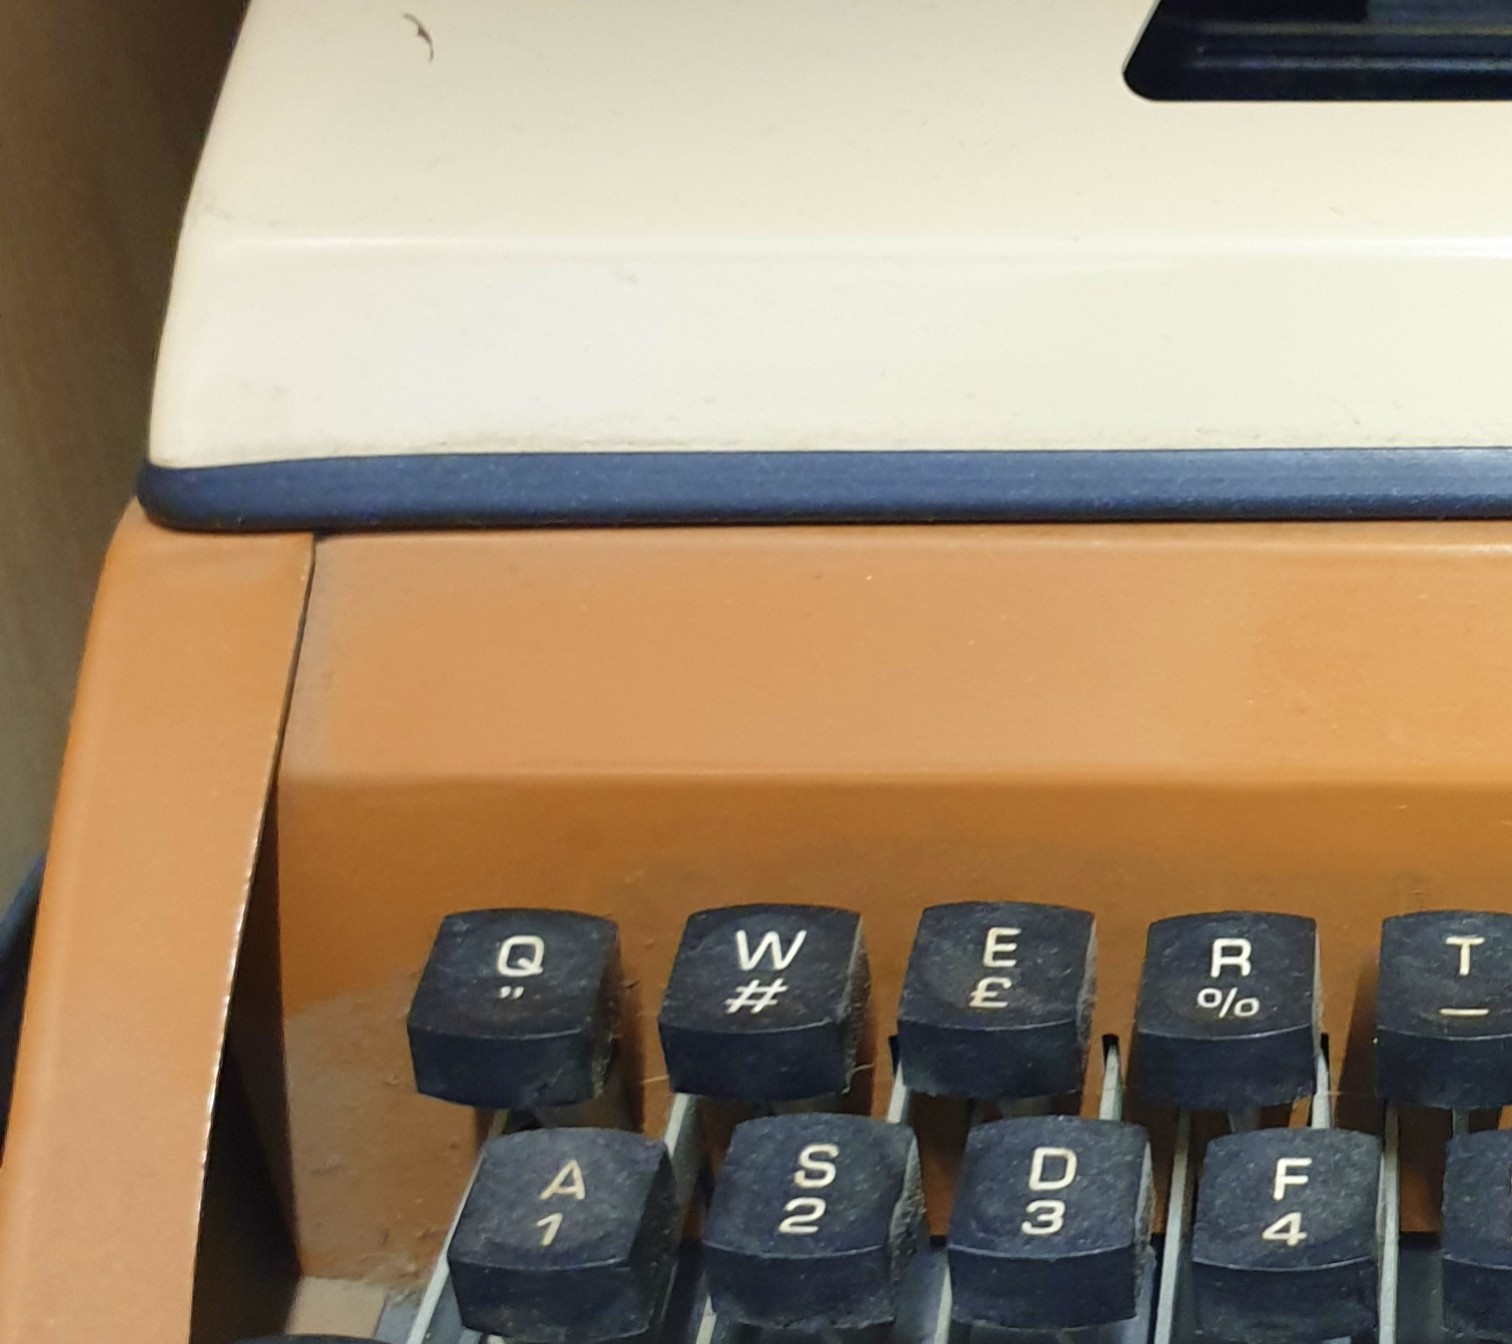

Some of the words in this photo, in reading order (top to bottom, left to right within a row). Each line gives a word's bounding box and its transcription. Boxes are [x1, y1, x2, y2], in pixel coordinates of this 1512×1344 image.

[496, 935, 545, 977] Q
[735, 930, 807, 971] W
[983, 927, 1021, 968] E
[1210, 937, 1252, 978] R
[1445, 935, 1485, 976] T
[725, 977, 788, 1014] #
[969, 976, 1012, 1008] £
[1197, 987, 1260, 1018] %
[540, 1159, 586, 1200] A
[794, 1143, 839, 1188] S
[1028, 1147, 1077, 1191] D
[1273, 1157, 1313, 1201] F
[536, 1212, 563, 1246] 1
[778, 1197, 826, 1234] 2
[1021, 1199, 1066, 1235] 3
[1262, 1212, 1307, 1246] 4
